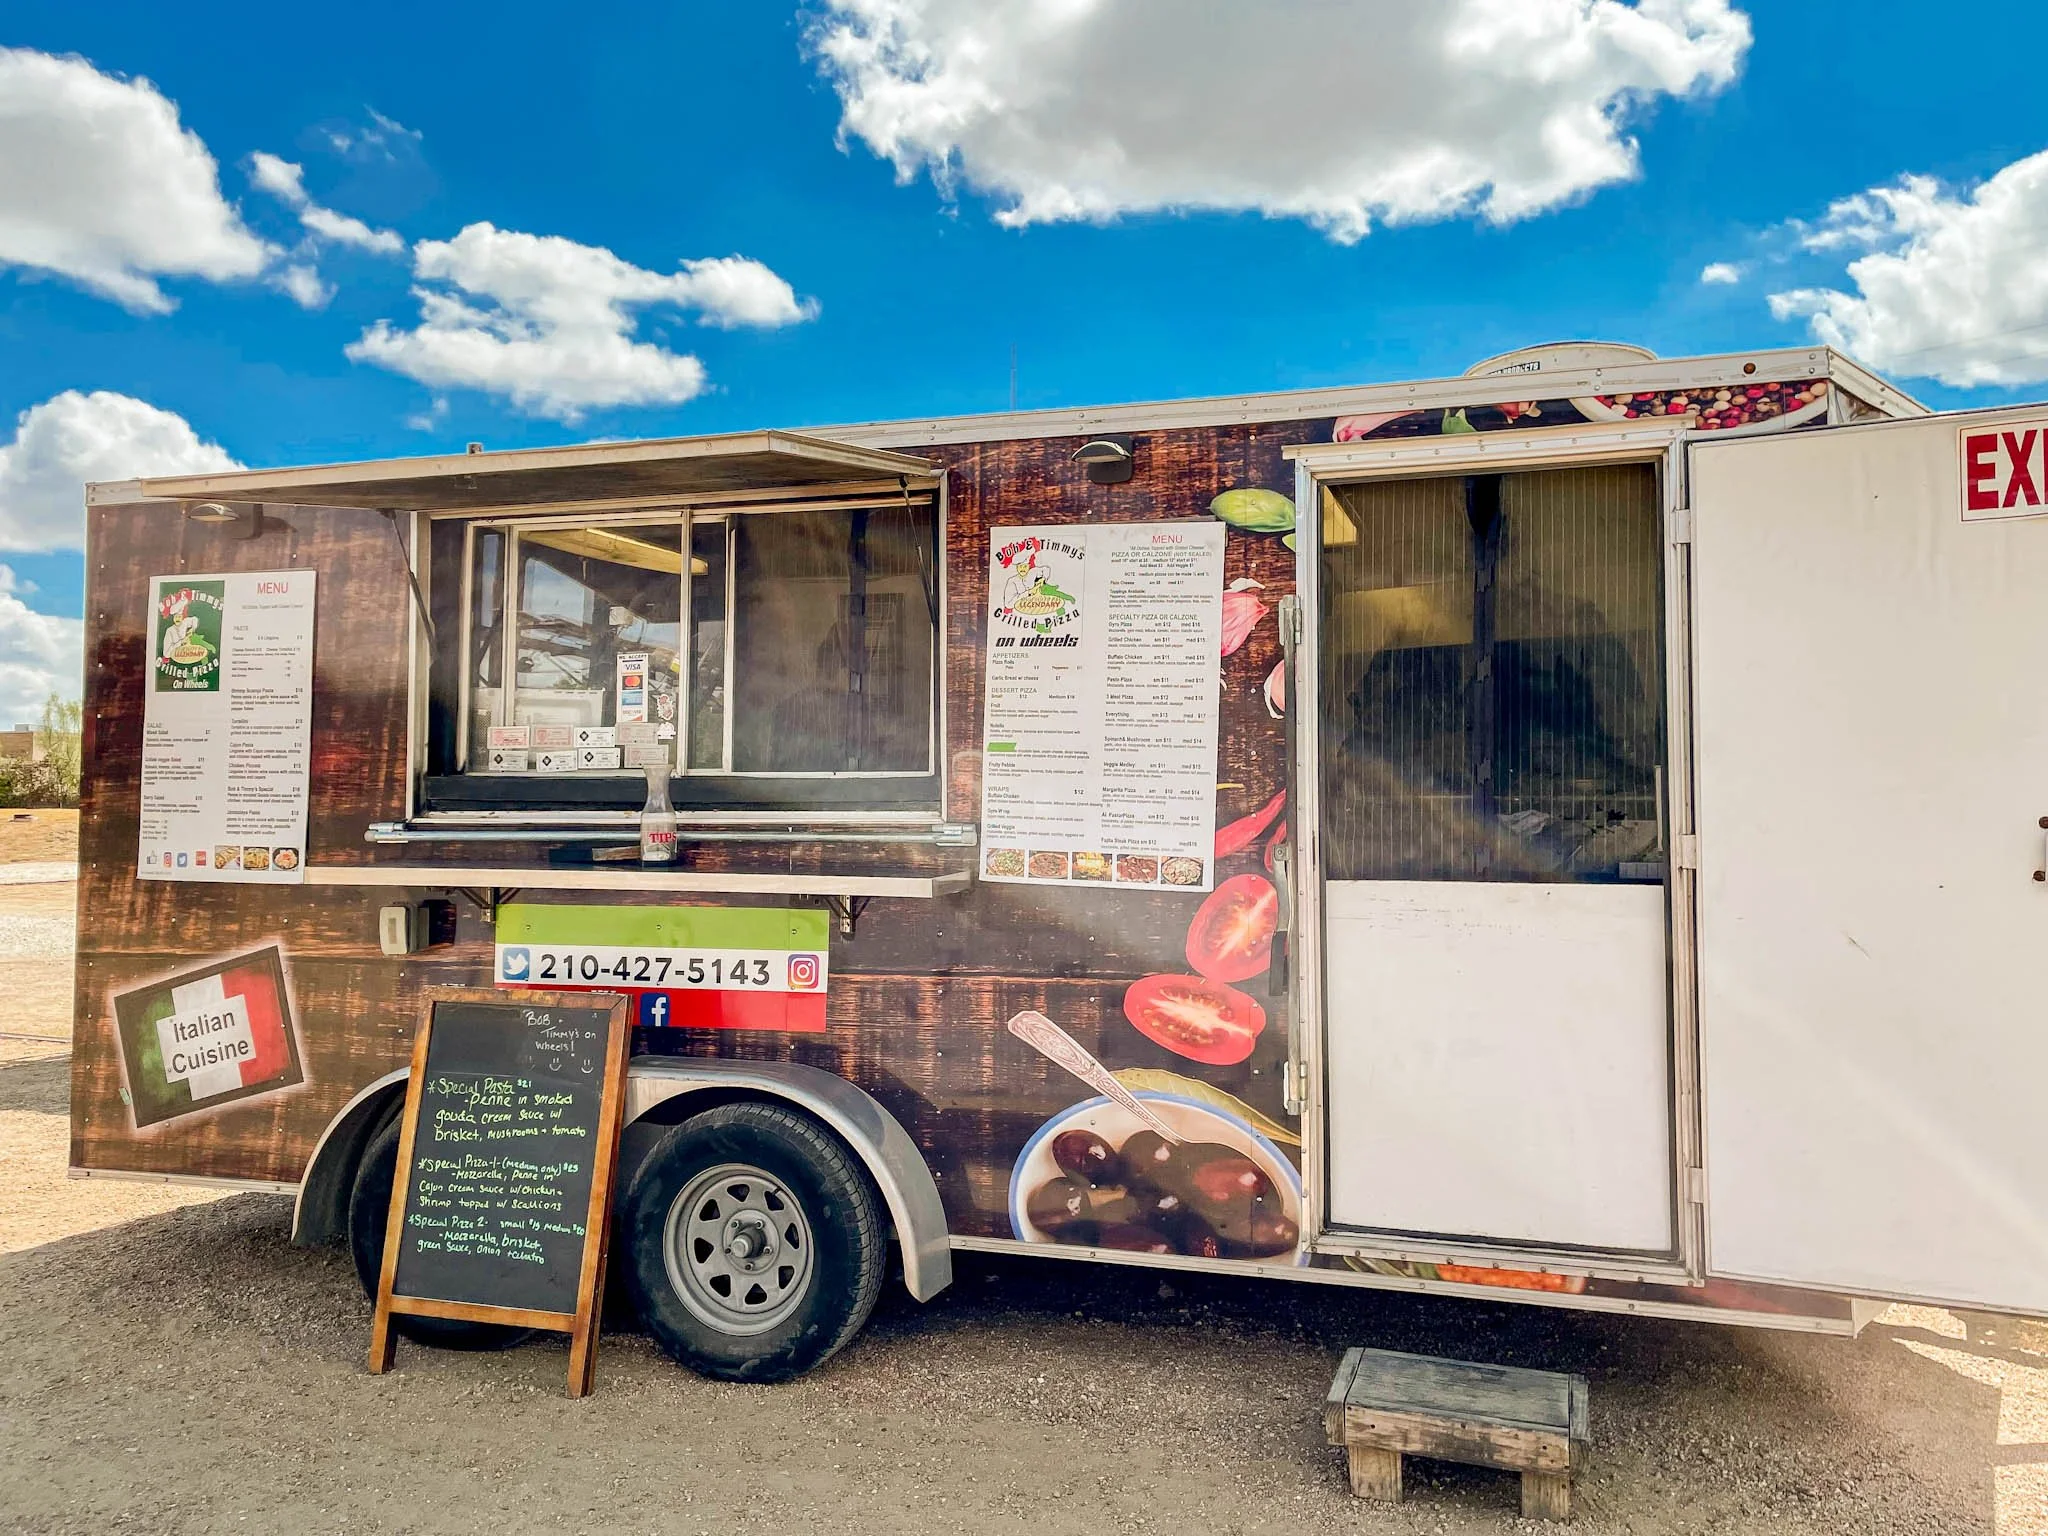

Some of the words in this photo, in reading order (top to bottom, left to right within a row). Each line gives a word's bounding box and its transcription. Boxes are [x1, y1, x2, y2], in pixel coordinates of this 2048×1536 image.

[1039, 539, 1085, 560] Timmys
[257, 583, 288, 594] MENU
[1020, 600, 1060, 608] LEGENDARY
[994, 608, 1036, 629] Grilled
[1045, 609, 1080, 628] Pizza
[996, 637, 1014, 647] on
[1021, 634, 1078, 647] wheels
[156, 657, 187, 678] Grilled
[192, 659, 219, 677] Pizza
[173, 680, 183, 688] On
[184, 680, 208, 688] Wheels
[649, 832, 677, 843] TIPS
[540, 954, 770, 985] 210-427-5143
[173, 1011, 235, 1043] Italian
[172, 1040, 249, 1074] Cuisine
[484, 1078, 515, 1094] Pasta
[517, 1079, 531, 1088] $21
[518, 1096, 527, 1104] in
[482, 1113, 511, 1124] cream
[552, 1125, 585, 1136] tomato
[544, 1172, 553, 1181] in
[419, 1180, 443, 1195] Cajun
[459, 1198, 488, 1210] topped
[452, 1216, 474, 1229] Pizza
[418, 1240, 440, 1253] green
